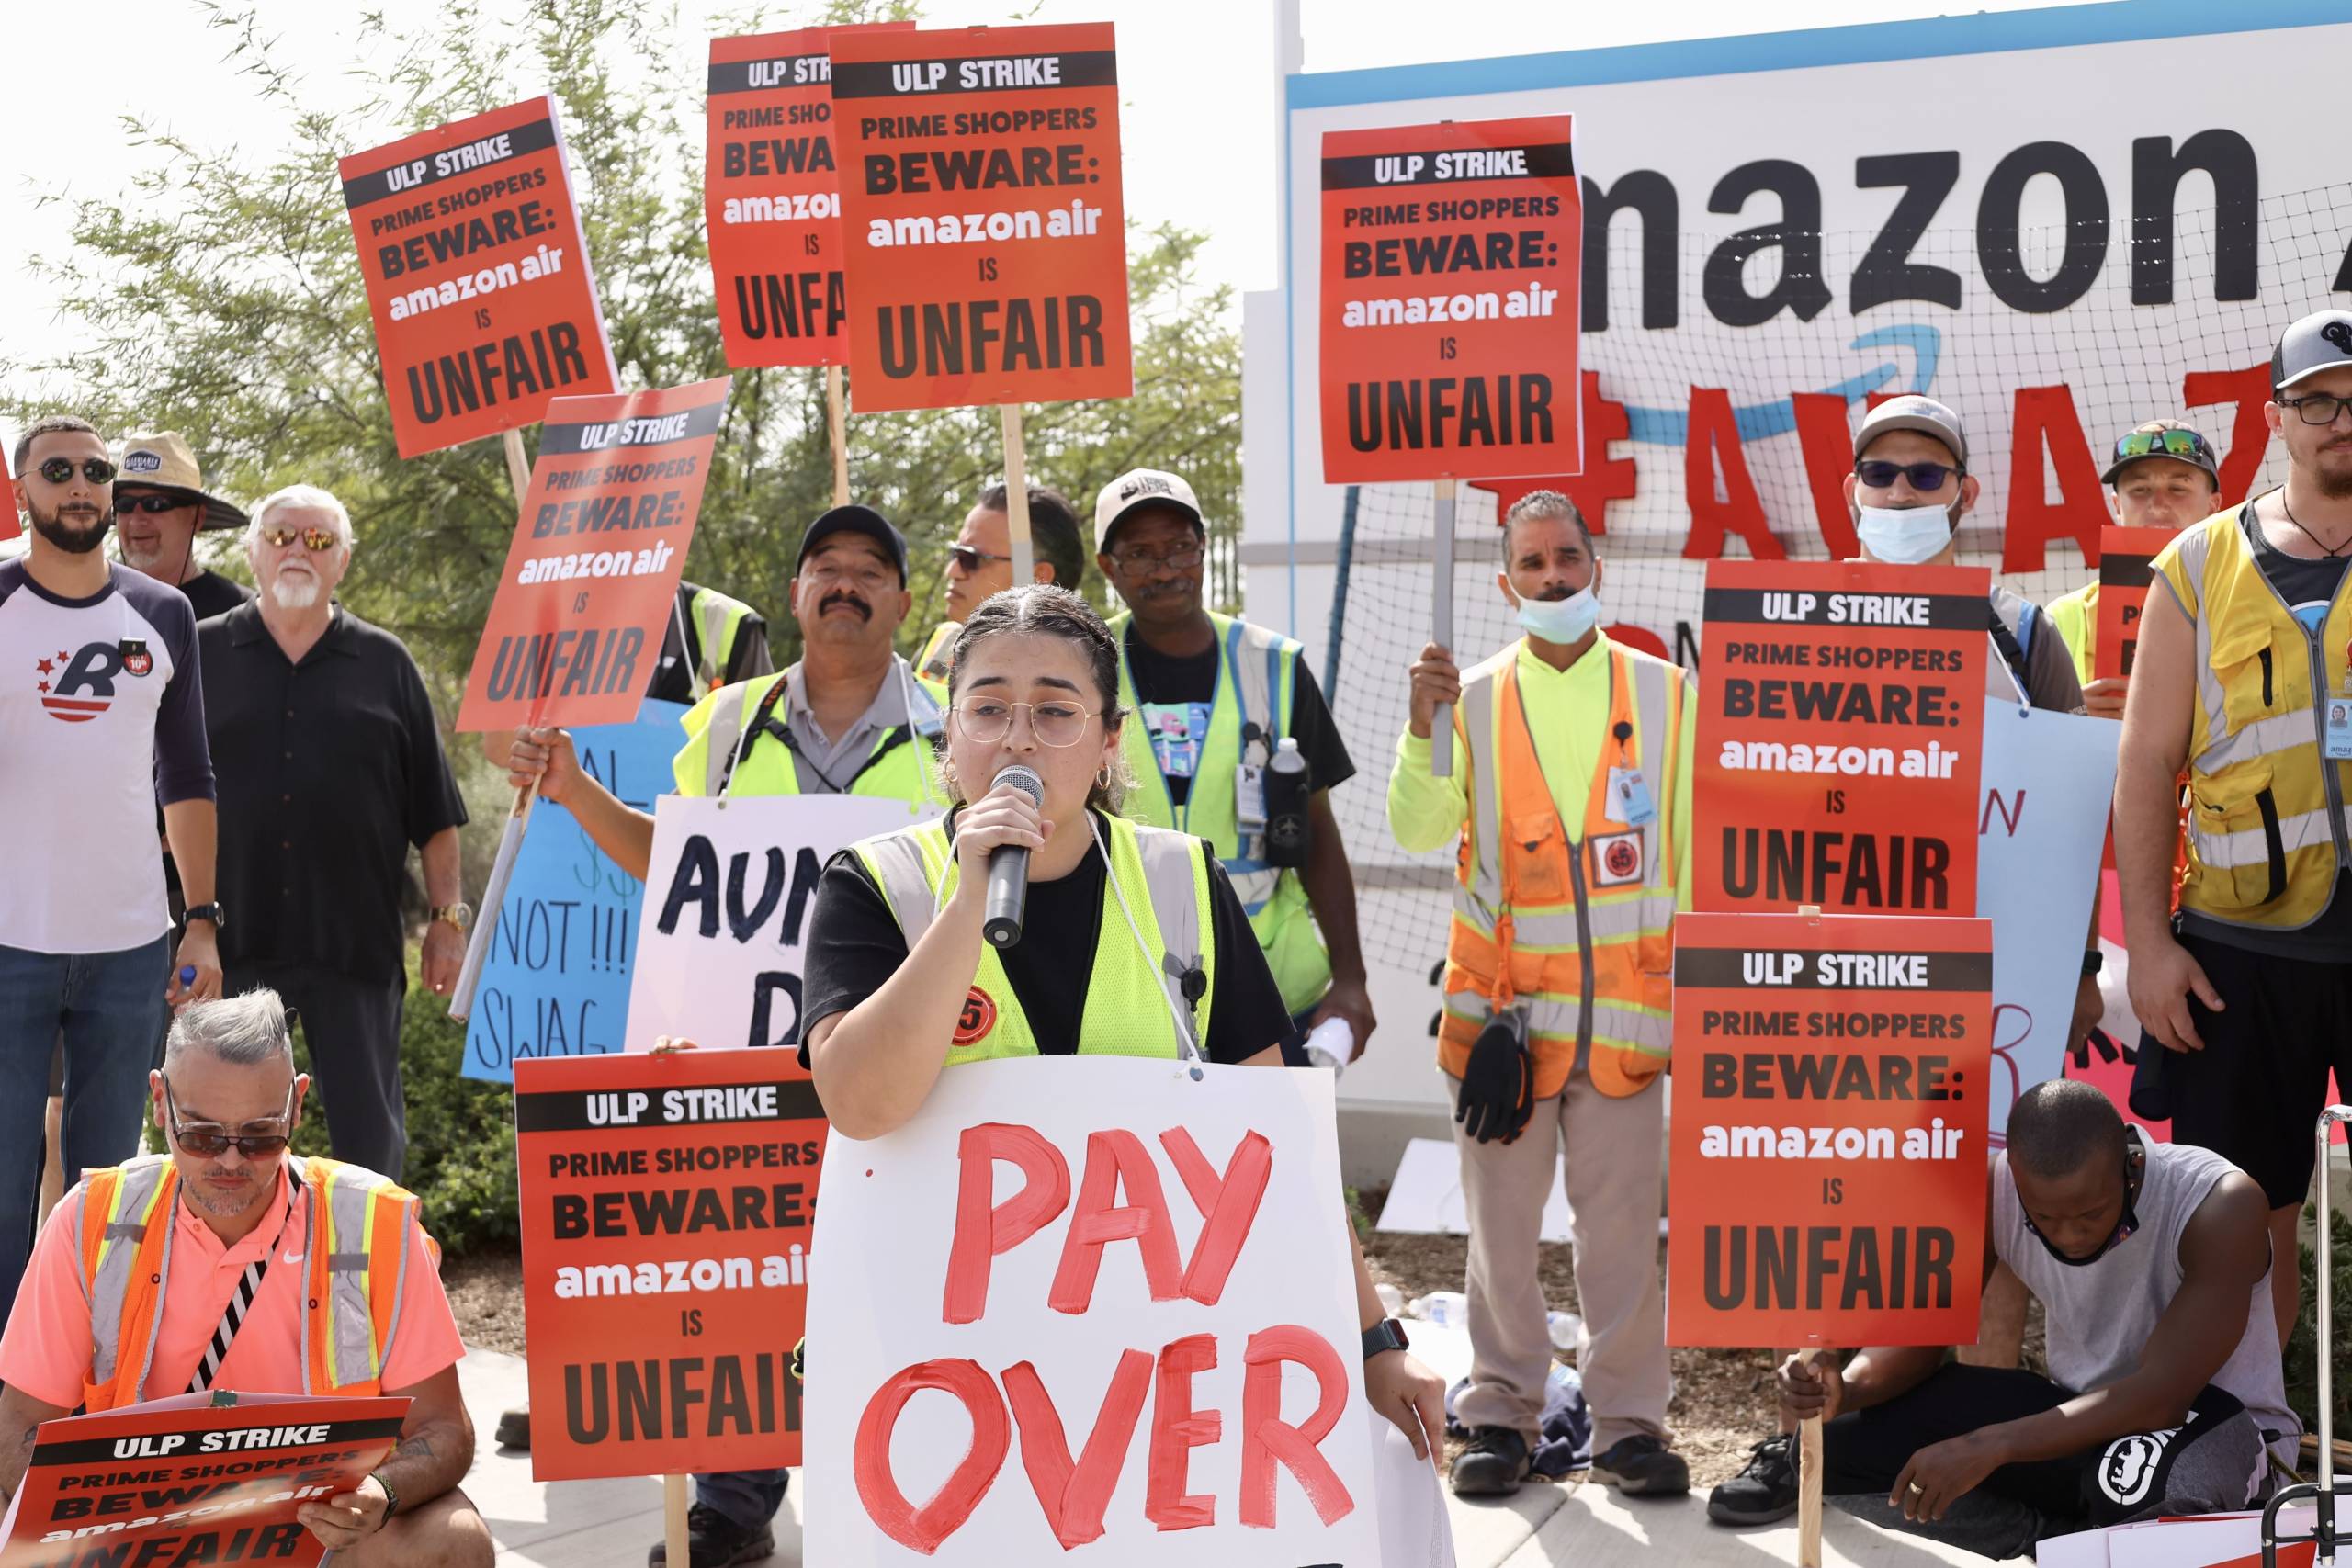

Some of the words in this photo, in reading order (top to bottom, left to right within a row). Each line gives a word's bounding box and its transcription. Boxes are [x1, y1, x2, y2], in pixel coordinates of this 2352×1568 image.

[748, 62, 786, 87] ULP
[794, 57, 831, 83] STR
[892, 62, 947, 92] ULP
[959, 57, 1061, 89] STRIKE
[724, 106, 784, 130] PRIME
[861, 115, 948, 140] PRIME
[955, 107, 1097, 135] SHOPPERS
[386, 161, 427, 192] ULP
[435, 134, 513, 177] STRIKE
[724, 136, 836, 177] BEWA
[864, 145, 1100, 196] BEWARE:
[1374, 156, 1424, 184] ULP
[1434, 150, 1528, 179] STRIKE
[371, 202, 435, 236] PRIME
[437, 168, 547, 216] SHOPPERS
[1343, 203, 1420, 228] PRIME
[1426, 196, 1560, 223] SHOPPERS
[378, 201, 556, 279] BEWARE:
[867, 206, 1041, 247] amazon
[1046, 199, 1102, 238] air
[805, 234, 819, 255] IS
[1344, 231, 1558, 279] BEWARE:
[390, 257, 517, 321] amazon
[521, 244, 562, 282] air
[978, 258, 998, 282] IS
[475, 309, 491, 330] IS
[735, 271, 845, 340] UNFA
[1342, 290, 1499, 328] amazon
[1504, 281, 1558, 318] air
[876, 295, 1105, 379] UNFAIR
[1440, 337, 1456, 360] IS
[407, 321, 588, 424] UNFAIR
[580, 424, 617, 450] ULP
[619, 413, 688, 444] STRIKE
[1348, 373, 1554, 453] UNFAIR
[545, 469, 601, 491] PRIME
[603, 456, 697, 485] SHOPPERS
[532, 491, 685, 539] BEWARE:
[518, 550, 634, 585] amazon
[634, 540, 674, 575] air
[573, 592, 589, 614] IS
[1762, 592, 1816, 621] ULP
[1827, 594, 1929, 626] STRIKE
[487, 627, 646, 703] UNFAIR
[1725, 642, 1811, 666] PRIME
[1816, 646, 1962, 672] SHOPPERS
[1724, 679, 1960, 728] BEWARE:
[1719, 740, 1894, 776] amazon
[1899, 740, 1959, 779] air
[1826, 790, 1845, 814] IS
[1722, 827, 1950, 910] UNFAIR
[1742, 953, 1804, 986] ULP
[1817, 953, 1928, 987] STRIKE
[475, 987, 608, 1070] SWAG
[1702, 1010, 1800, 1037] PRIME
[1806, 1011, 1966, 1039] SHOPPERS
[1702, 1053, 1964, 1101] BEWARE:
[586, 1093, 649, 1126] ULP
[662, 1086, 778, 1122] STRIKE
[1699, 1124, 1895, 1160] amazon
[1901, 1117, 1963, 1160] air
[548, 1149, 649, 1179] PRIME
[656, 1141, 819, 1174] SHOPPERS
[1823, 1178, 1843, 1206] IS
[942, 1122, 1274, 1325] PAY
[553, 1255, 754, 1299] amazon
[759, 1243, 810, 1288] ai
[1702, 1225, 1955, 1311] UNFAIR
[681, 1309, 703, 1337] IS
[112, 1434, 186, 1459] ULP
[198, 1424, 331, 1454] STRIKE
[854, 1324, 1355, 1556] OVER
[58, 1472, 174, 1491] PRIME
[178, 1450, 361, 1481] SHOPPERS
[39, 1497, 260, 1544] amazon
[261, 1484, 335, 1504] air
